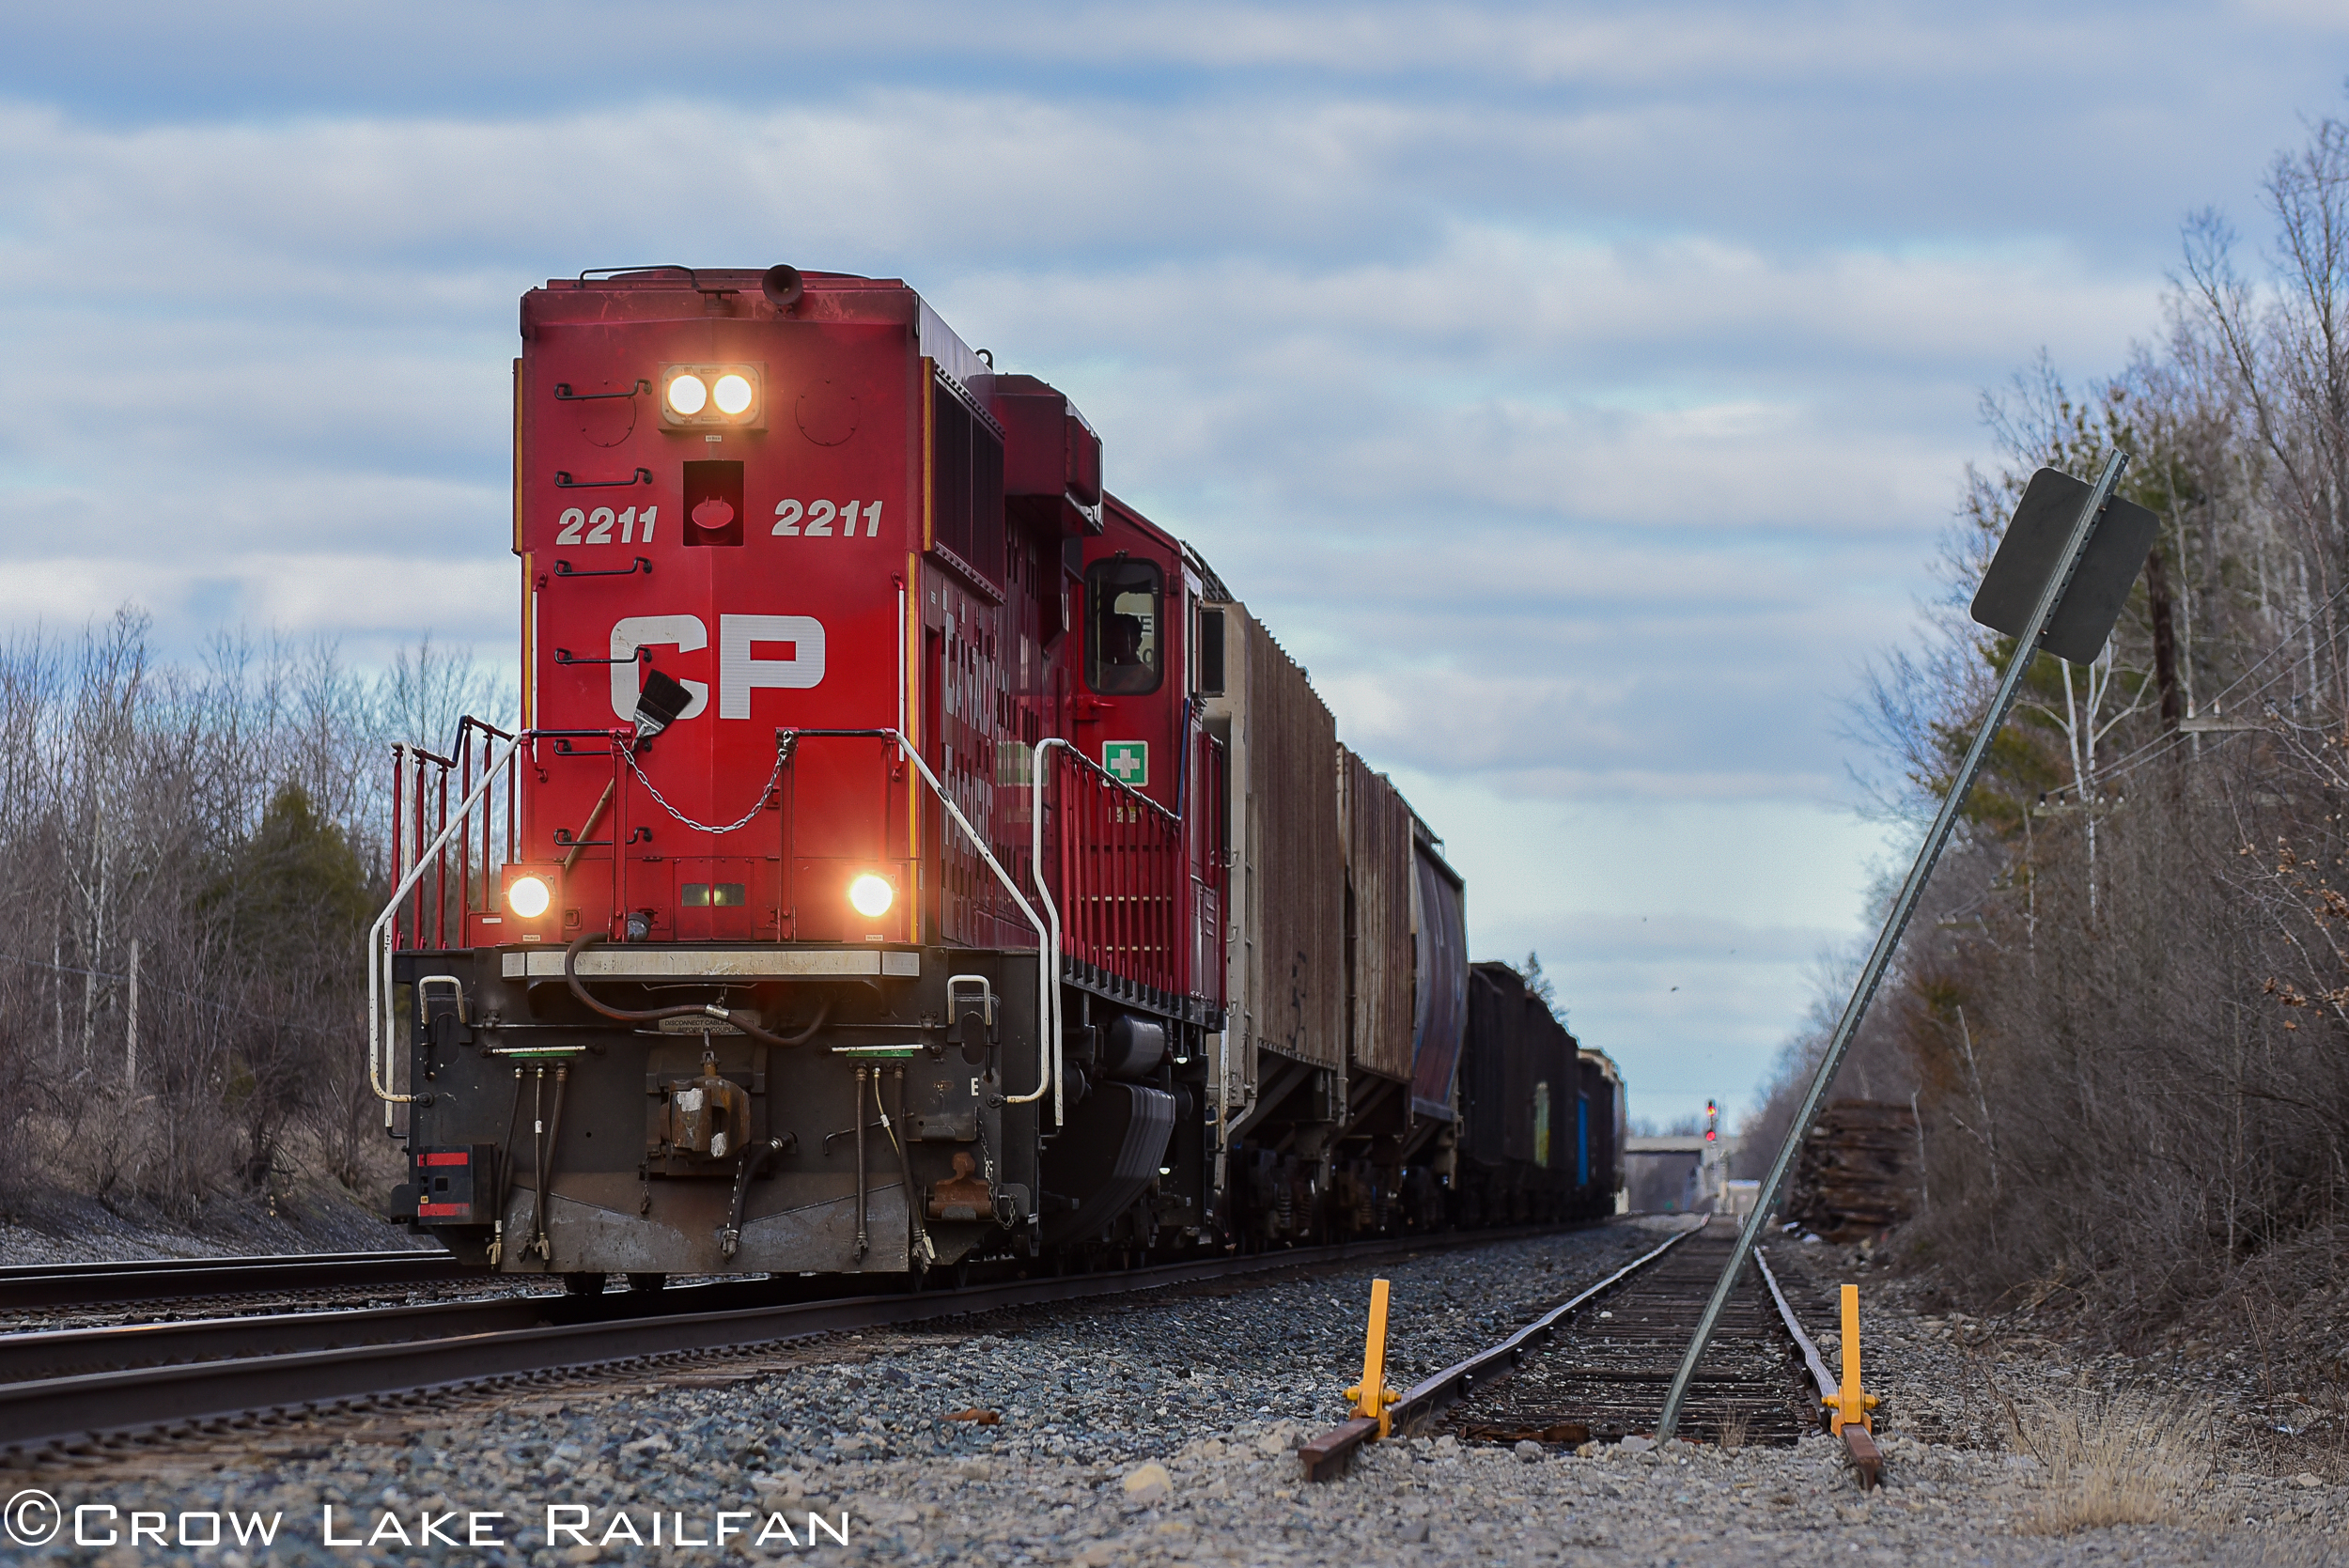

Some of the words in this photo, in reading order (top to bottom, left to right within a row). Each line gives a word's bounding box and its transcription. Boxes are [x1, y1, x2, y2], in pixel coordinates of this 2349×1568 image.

[556, 505, 658, 545] 2211
[771, 499, 883, 537] 2211
[611, 613, 826, 722] CP
[945, 612, 1010, 744] CANADIAN
